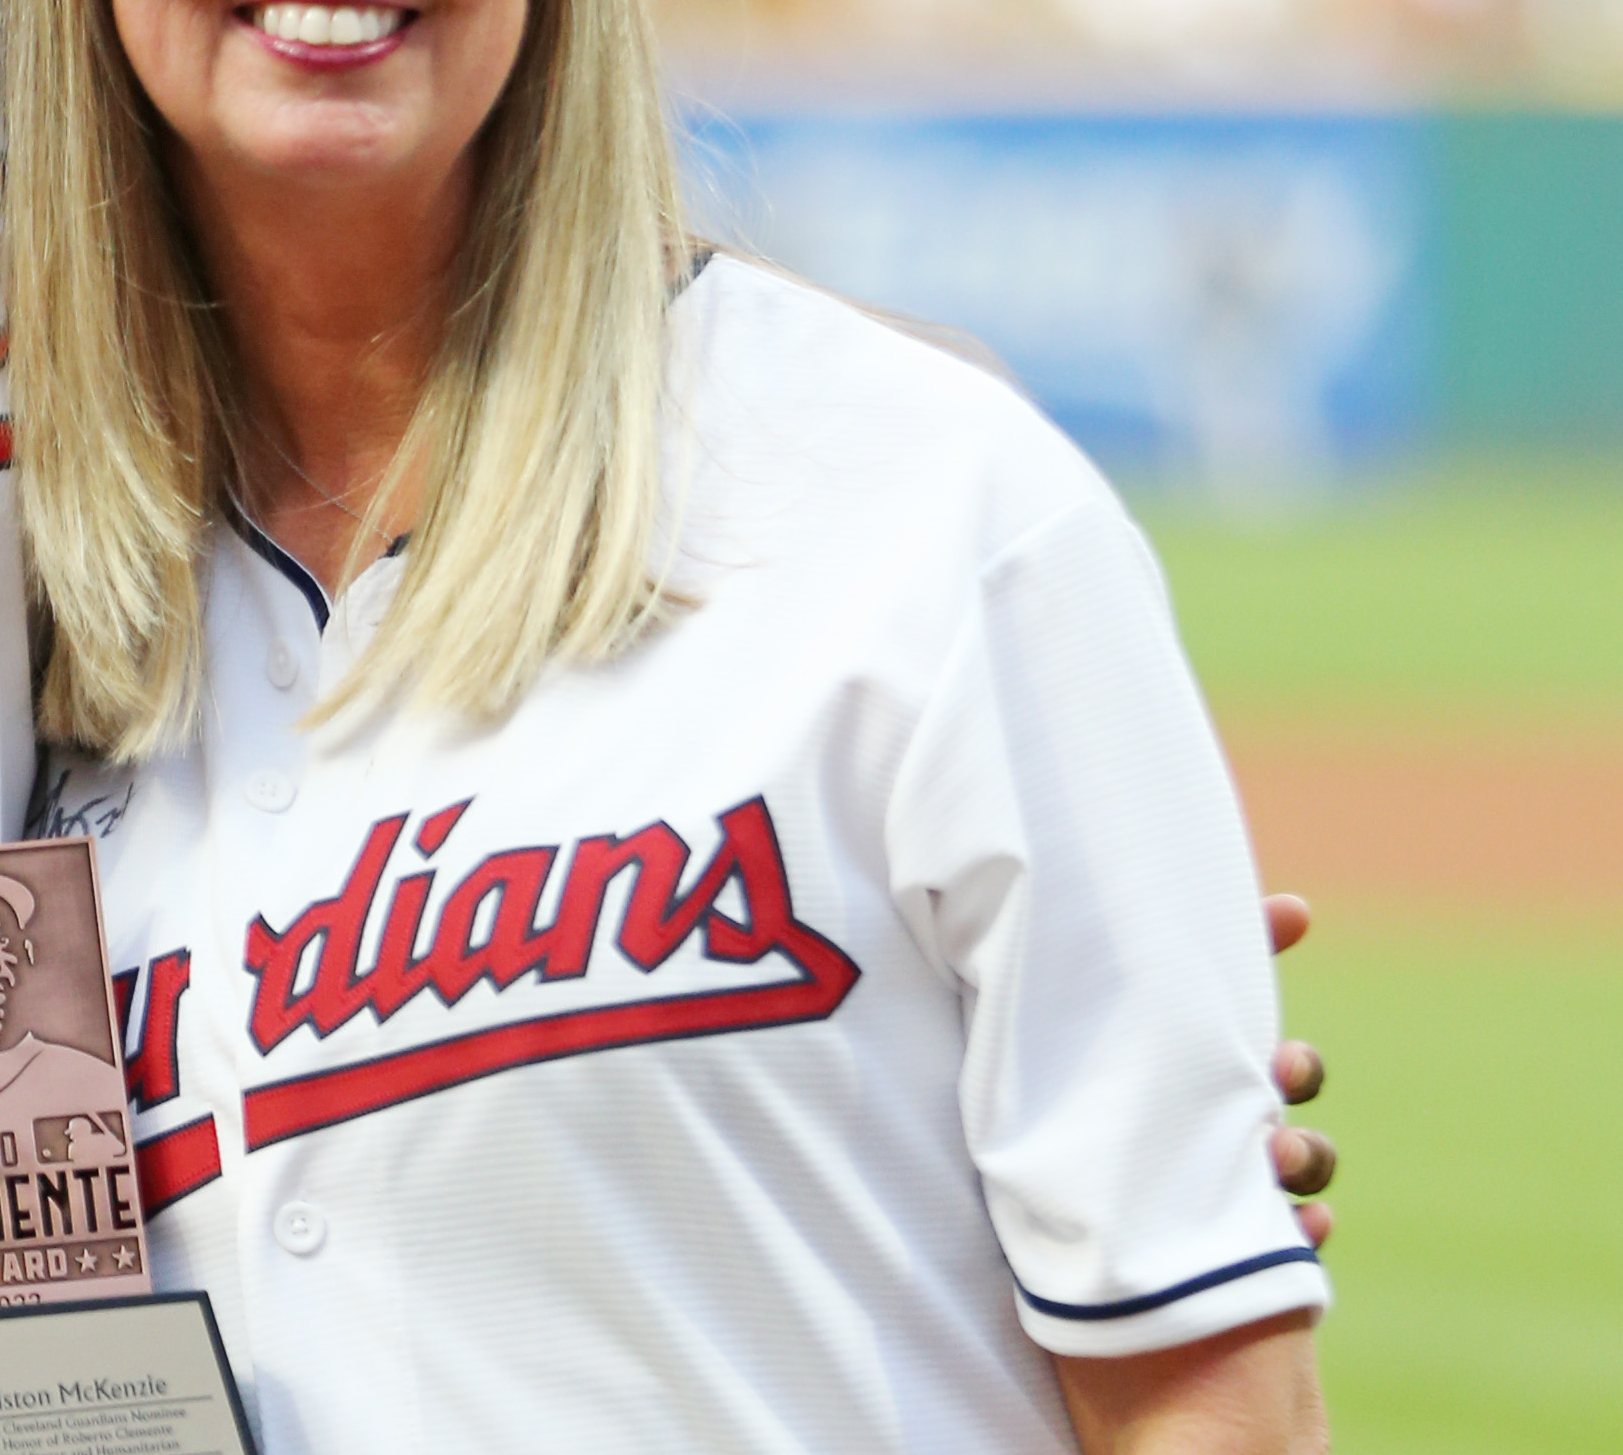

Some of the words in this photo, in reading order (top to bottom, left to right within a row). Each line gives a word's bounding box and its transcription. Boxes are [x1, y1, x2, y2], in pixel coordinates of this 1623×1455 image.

[56, 1373, 168, 1406] McKenzie
[2, 1416, 63, 1436] Cleveland
[65, 1410, 128, 1430] Guardians
[130, 1406, 187, 1424] Nominee
[2, 1432, 43, 1451] Honor
[62, 1427, 114, 1445] Roberto
[114, 1423, 174, 1441] Clemente
